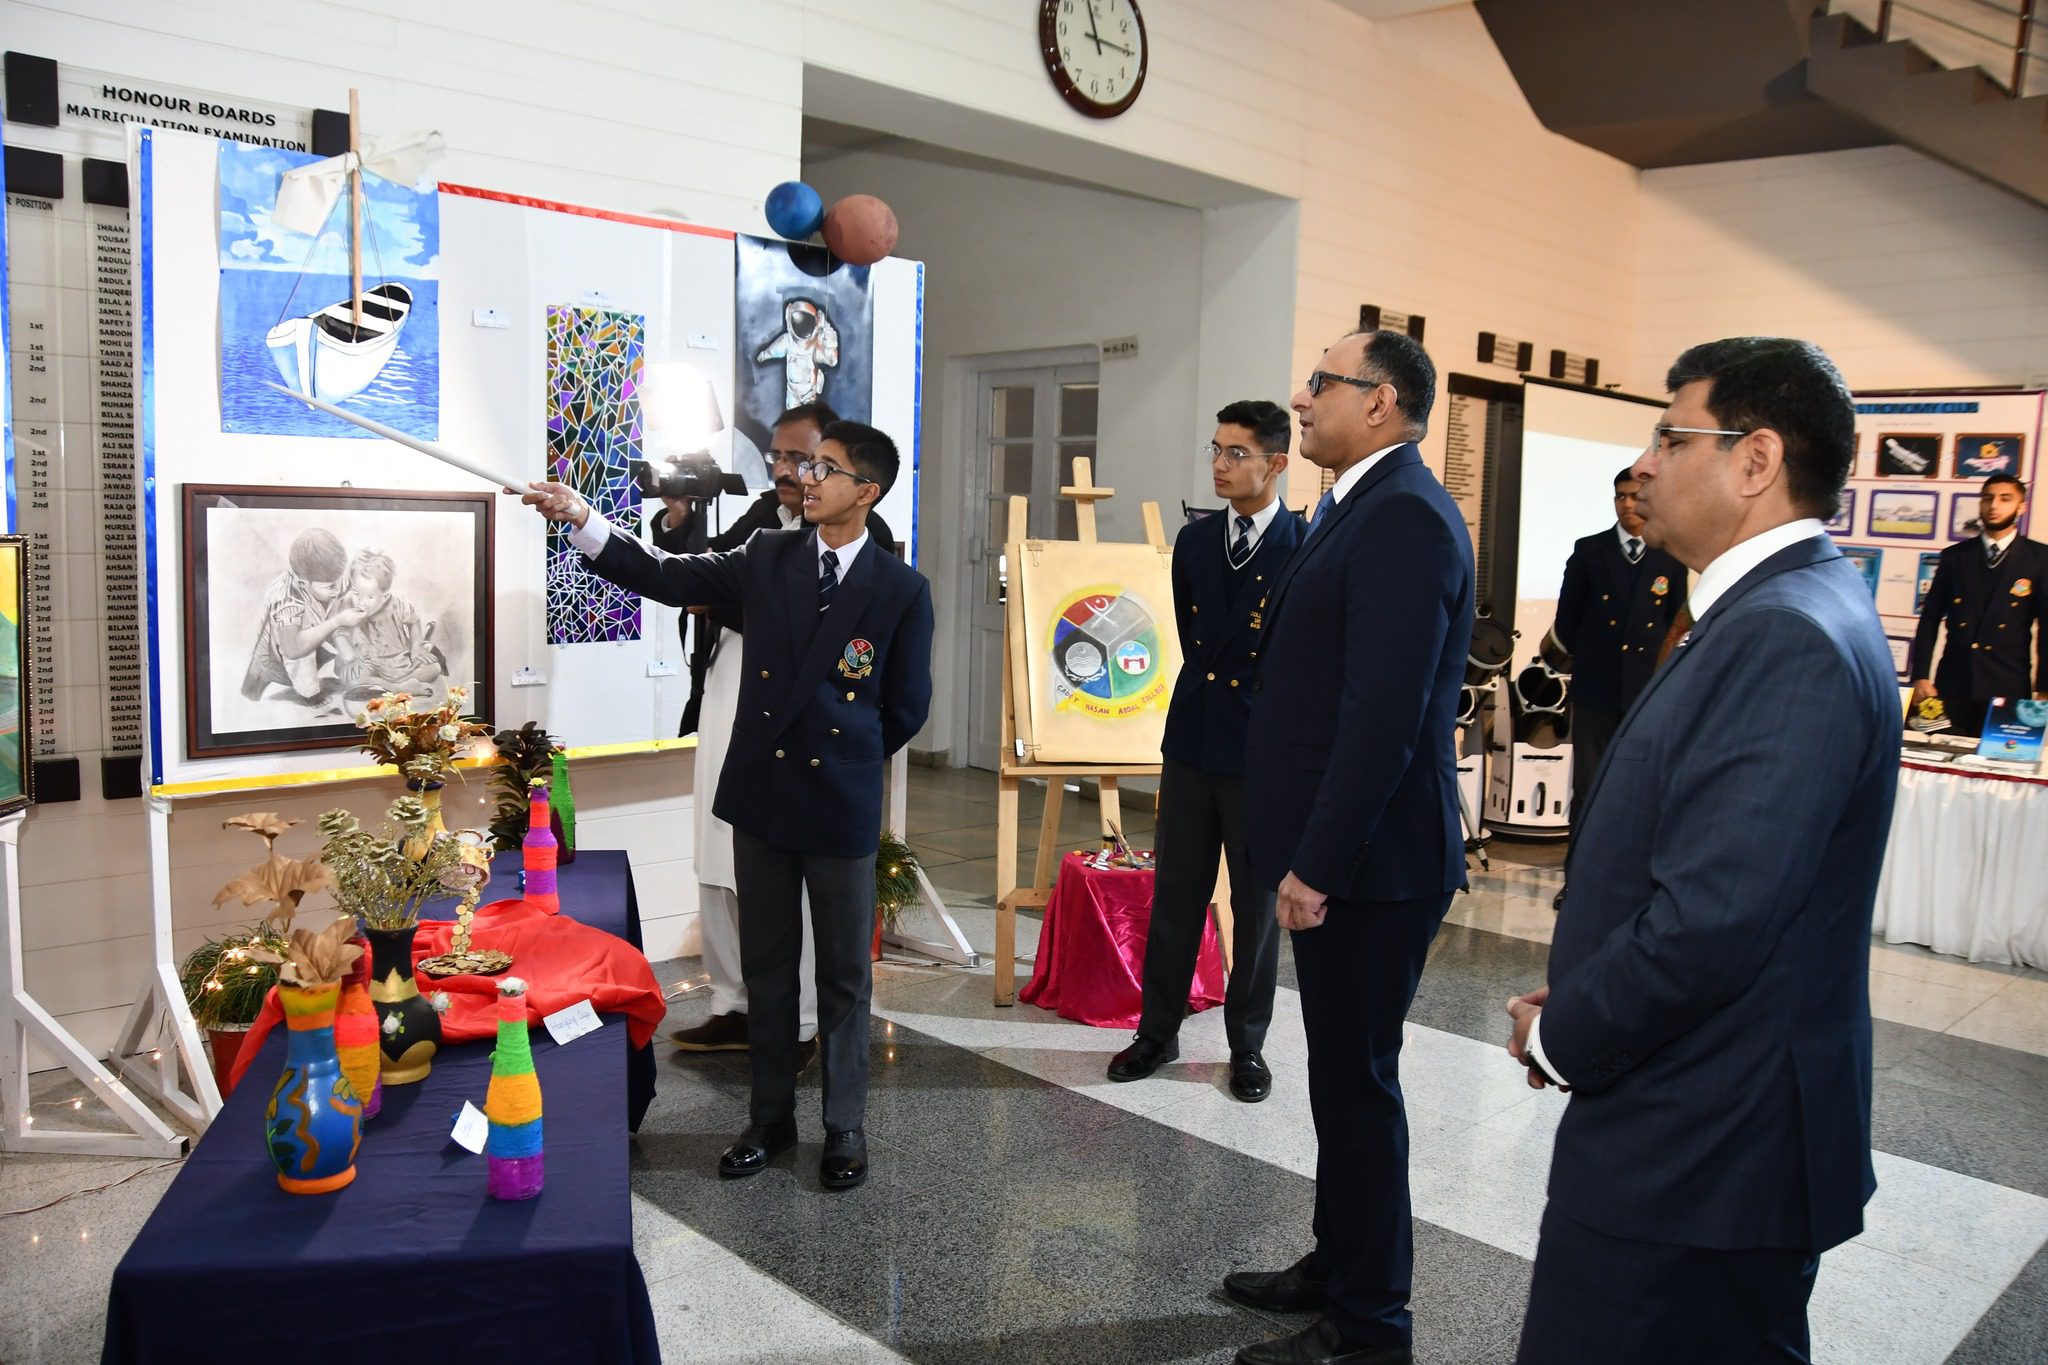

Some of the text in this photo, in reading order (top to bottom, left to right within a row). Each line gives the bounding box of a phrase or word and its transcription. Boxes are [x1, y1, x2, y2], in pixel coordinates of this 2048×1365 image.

[1059, 21, 1067, 36] 9
[1120, 19, 1127, 33] 2
[1063, 46, 1070, 61] 8
[1075, 68, 1082, 82] 7
[1091, 80, 1098, 95] 6
[1107, 78, 1114, 93] 5
[103, 84, 276, 126] HONOUR BOARDS
[204, 127, 306, 152] EXAMINATION
[16, 198, 53, 211] POSITION
[98, 224, 124, 233] IMRAN
[98, 245, 131, 255] MUMTAZ
[98, 266, 127, 274] KASHIF
[98, 277, 124, 285] ABDUL
[1085, 704, 1109, 715] HASAN
[1118, 704, 1140, 715] ABDAL
